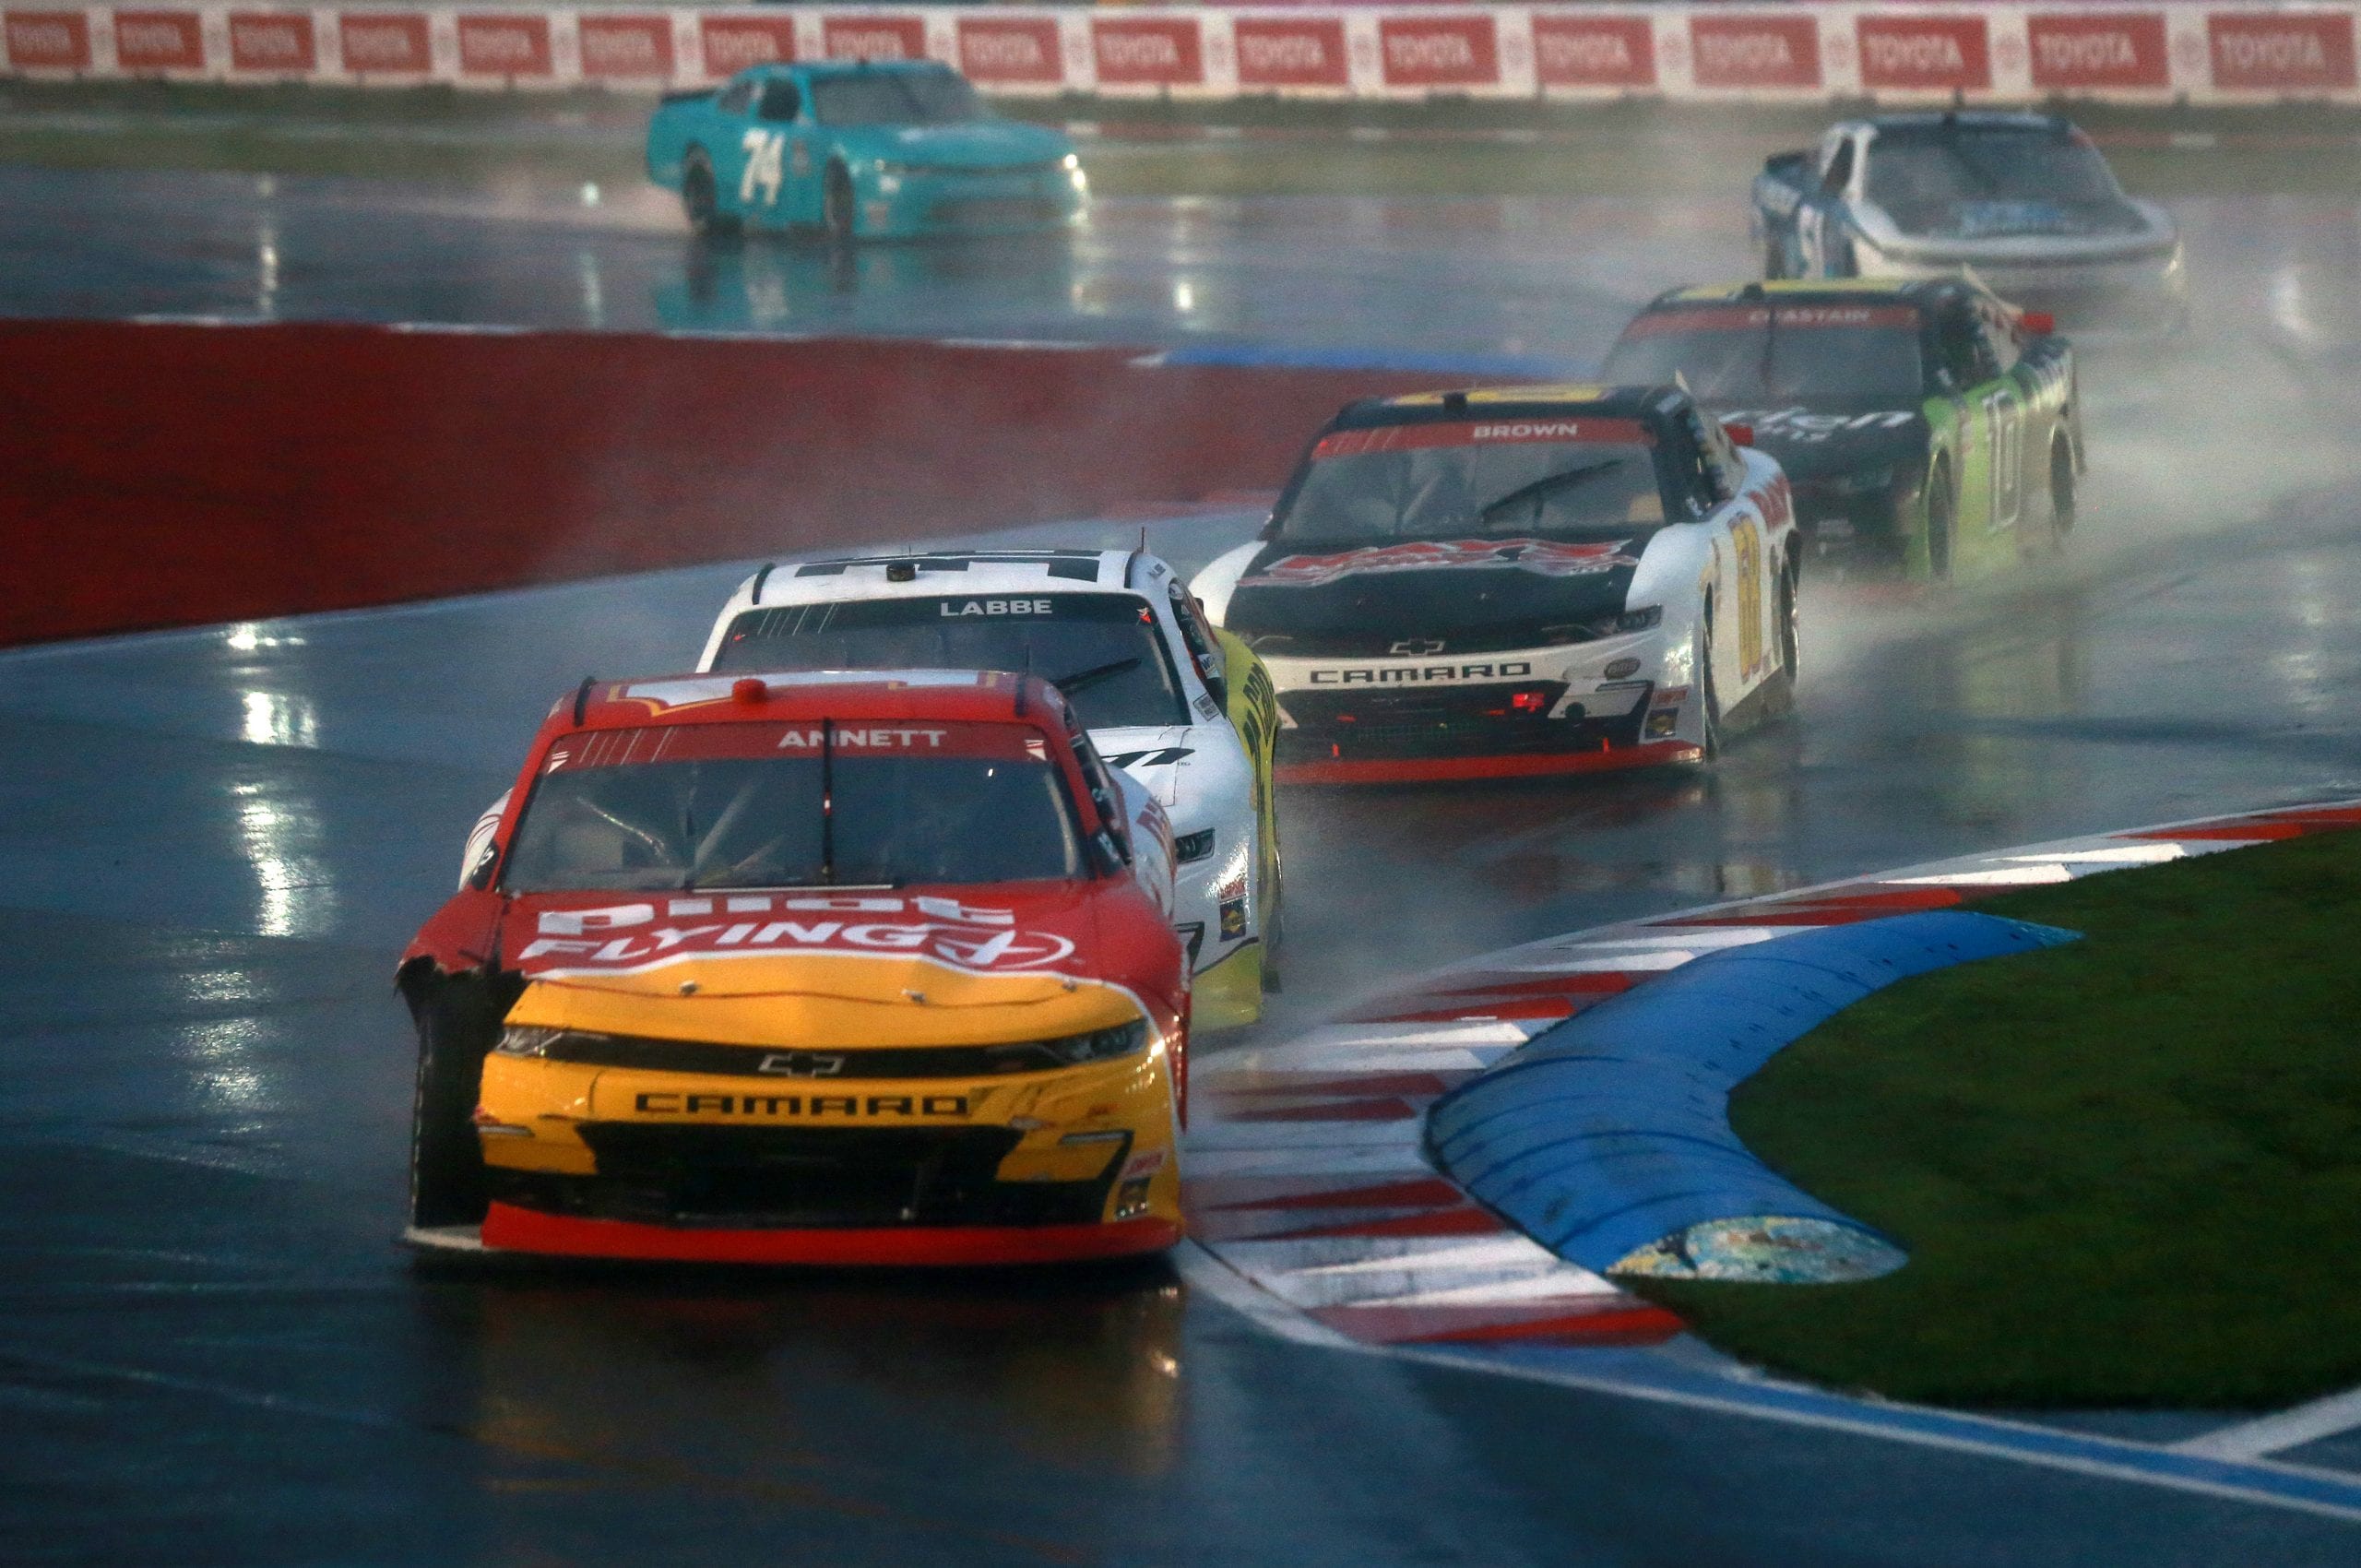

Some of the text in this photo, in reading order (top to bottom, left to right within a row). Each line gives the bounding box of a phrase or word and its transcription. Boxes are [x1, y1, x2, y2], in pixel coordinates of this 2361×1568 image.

[1866, 33, 1964, 68] TOYOTA
[2036, 33, 2139, 68] TOYOTA
[2219, 33, 2324, 68] TOYOTA
[1474, 424, 1578, 438] BROWN
[941, 600, 1053, 617] LABBE
[1311, 662, 1531, 683] CAMARO
[778, 730, 947, 748] ANNETT
[517, 922, 931, 961] FLYING
[635, 1093, 968, 1116] CAMARO
